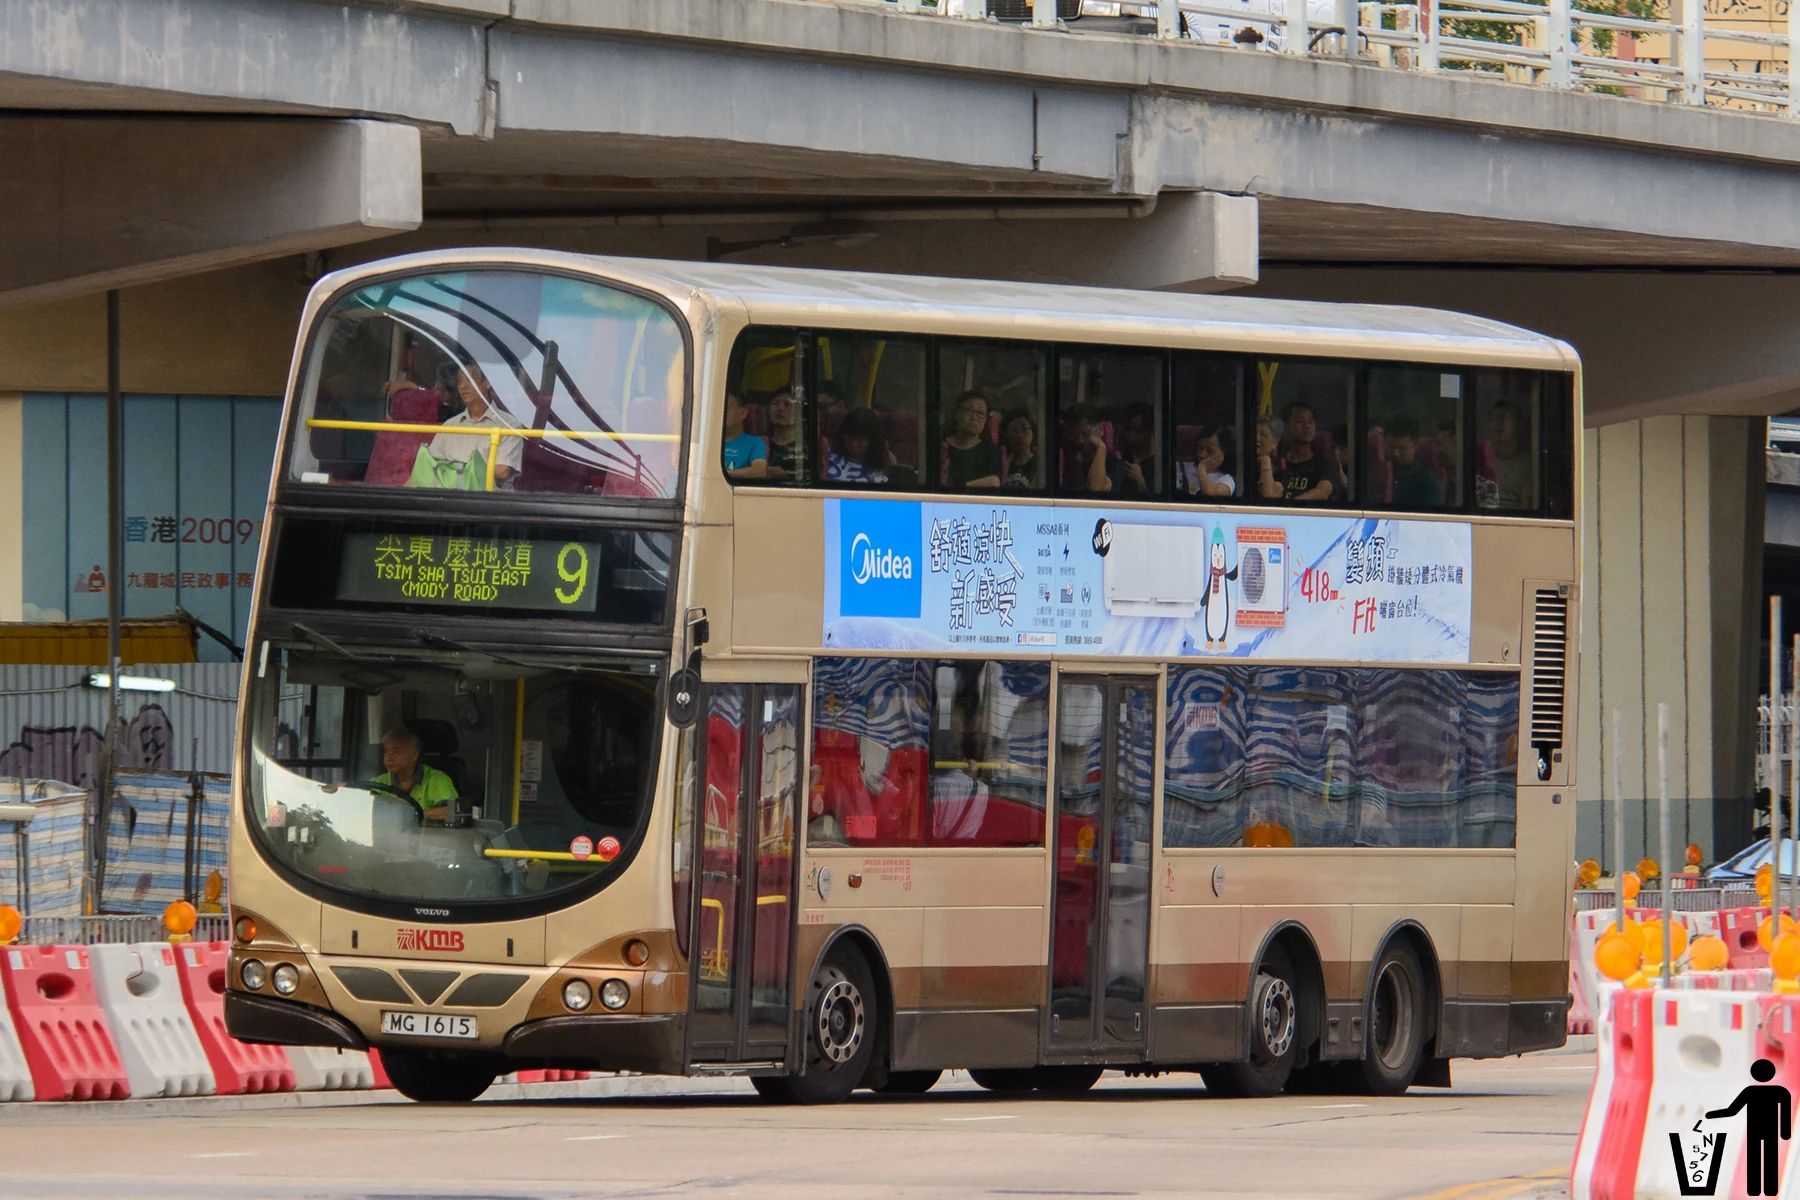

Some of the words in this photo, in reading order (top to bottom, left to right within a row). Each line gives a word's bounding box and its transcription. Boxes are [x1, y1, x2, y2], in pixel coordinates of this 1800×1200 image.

[125, 516, 263, 545] 香港2009
[374, 535, 434, 565] 尖東
[851, 533, 912, 584] Midea
[375, 563, 413, 580] TSIM
[417, 566, 445, 582] SHA
[451, 567, 487, 584] TSUI
[491, 569, 530, 586] EAST
[555, 542, 588, 604] 9
[401, 581, 449, 598] (MODY
[453, 584, 499, 601] ROAD)
[949, 567, 1017, 630] 新感受
[1352, 597, 1377, 634] Fit
[414, 907, 450, 916] VOLVO
[416, 929, 465, 952] KMB
[390, 1014, 415, 1032] MG
[424, 1016, 470, 1035] 1615
